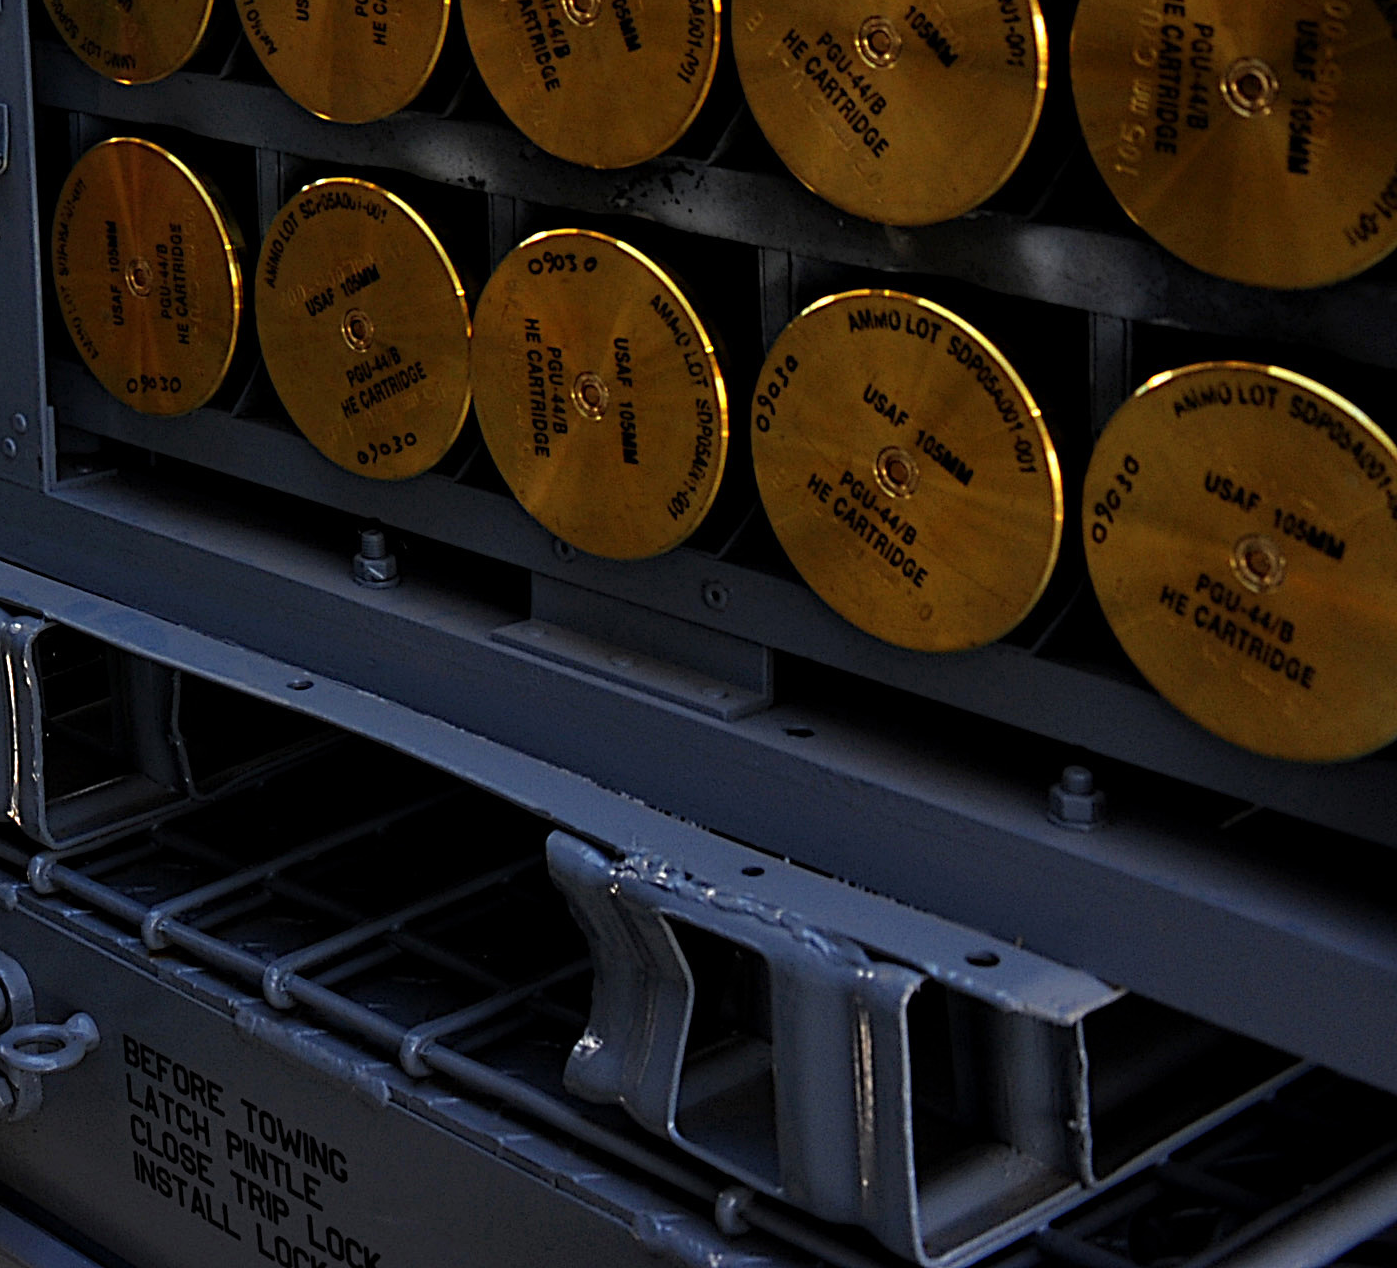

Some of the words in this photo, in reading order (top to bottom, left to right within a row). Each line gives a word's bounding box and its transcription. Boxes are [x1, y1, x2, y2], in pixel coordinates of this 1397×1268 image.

[373, 21, 387, 47] HE
[815, 33, 889, 118] PGU-44/B
[903, 4, 961, 70] 105MM
[1187, 21, 1215, 133] PGU-44/B
[782, 28, 804, 62] HE
[805, 55, 891, 159] CARTRIDGE
[1154, 24, 1185, 157] CARTRIDGE
[156, 243, 173, 320] PGU-44/B
[169, 223, 189, 322] CARTRIDGE
[263, 242, 285, 289] AMMO
[279, 211, 301, 247] LOT
[110, 284, 125, 326] USAF
[175, 327, 190, 345] HE
[305, 288, 335, 318] USAF
[524, 317, 542, 344] HE
[341, 393, 361, 420] HE
[359, 361, 428, 409] CARTRIDGE
[345, 345, 402, 388] PGU-44/B
[527, 349, 551, 459] CARTRIDGE
[546, 345, 568, 436] PGU-44/B
[613, 337, 634, 388] USAF
[847, 309, 902, 334] AMMO
[905, 313, 942, 345] LOT
[946, 334, 1037, 475] SDP05A001-001
[1172, 381, 1233, 418] AMMO
[1237, 387, 1278, 409] LOT
[618, 400, 640, 466] 105MM
[862, 382, 910, 429] USAF
[914, 430, 975, 488] 105MM
[807, 472, 832, 505] HE
[833, 496, 930, 589] CARTRIDGE
[839, 470, 918, 548] PGU-44/B
[1091, 453, 1141, 545] 09030
[1203, 469, 1263, 514] USAF
[1272, 507, 1347, 562] 105MM
[1159, 585, 1190, 618] HE
[1194, 604, 1317, 690] CARTRIDGE
[1195, 572, 1296, 645] PGU-44/B
[123, 1033, 226, 1118] BEFORE
[240, 1098, 348, 1183] TOWING
[126, 1072, 211, 1147] LATCH
[225, 1129, 323, 1211] PINTLE
[130, 1114, 215, 1188] CLOSE
[230, 1169, 289, 1225] TRIP
[307, 1214, 381, 1268] LOCK
[133, 1150, 241, 1241] INSTALL
[256, 1222, 327, 1268] LOCK
